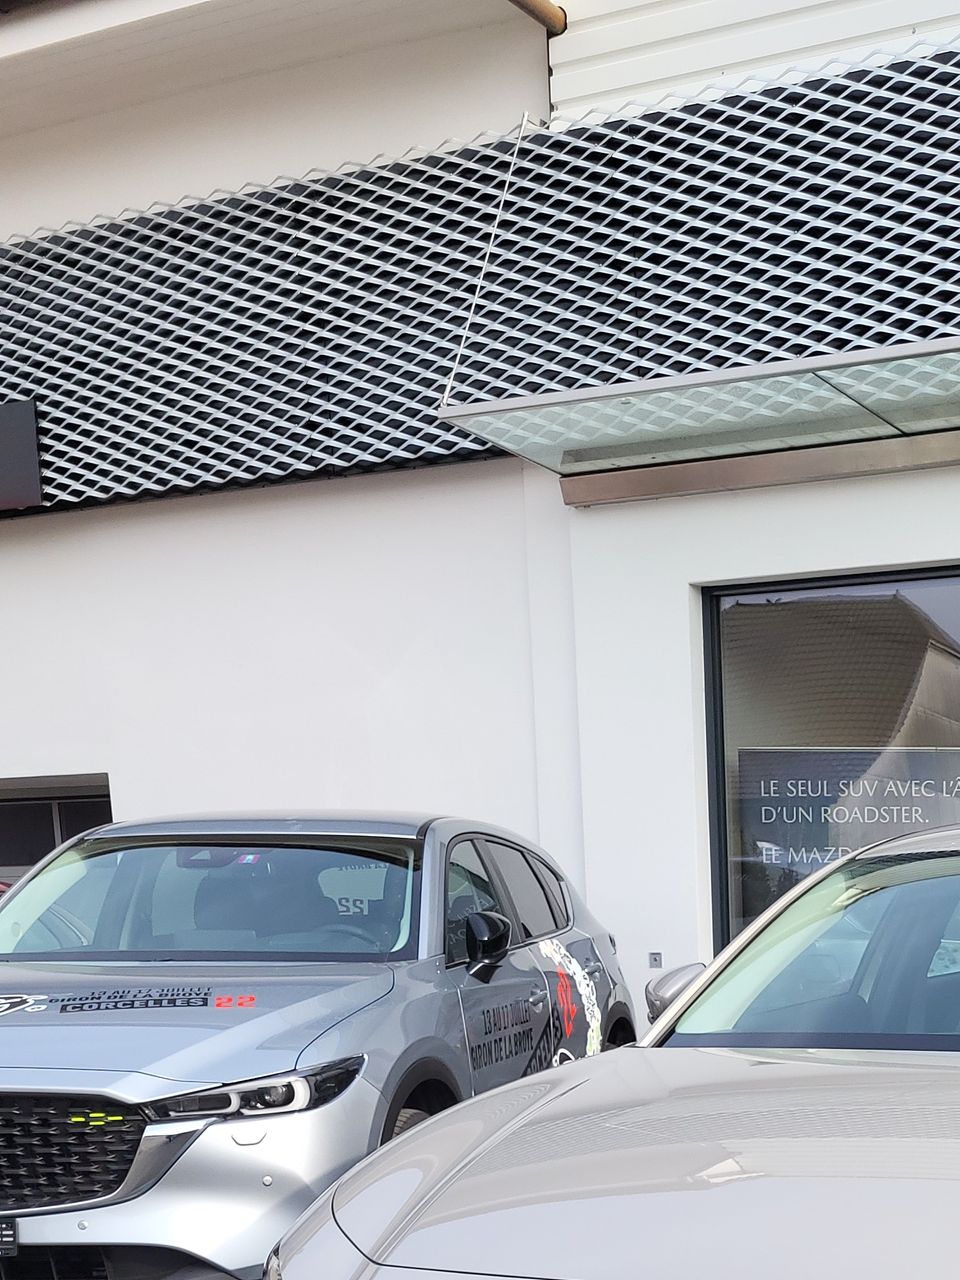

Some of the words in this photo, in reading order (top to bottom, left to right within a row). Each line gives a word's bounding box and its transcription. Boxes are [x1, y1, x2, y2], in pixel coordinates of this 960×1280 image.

[761, 780, 780, 797] LE
[786, 780, 832, 797] SEUL
[838, 780, 878, 797] SUV
[884, 779, 936, 797] AVEC
[761, 806, 813, 823] D'UN
[821, 806, 930, 823] ROADSTER.
[788, 847, 862, 863] MAZD
[65, 998, 206, 1012] CORCELLES
[214, 995, 257, 1008] 22
